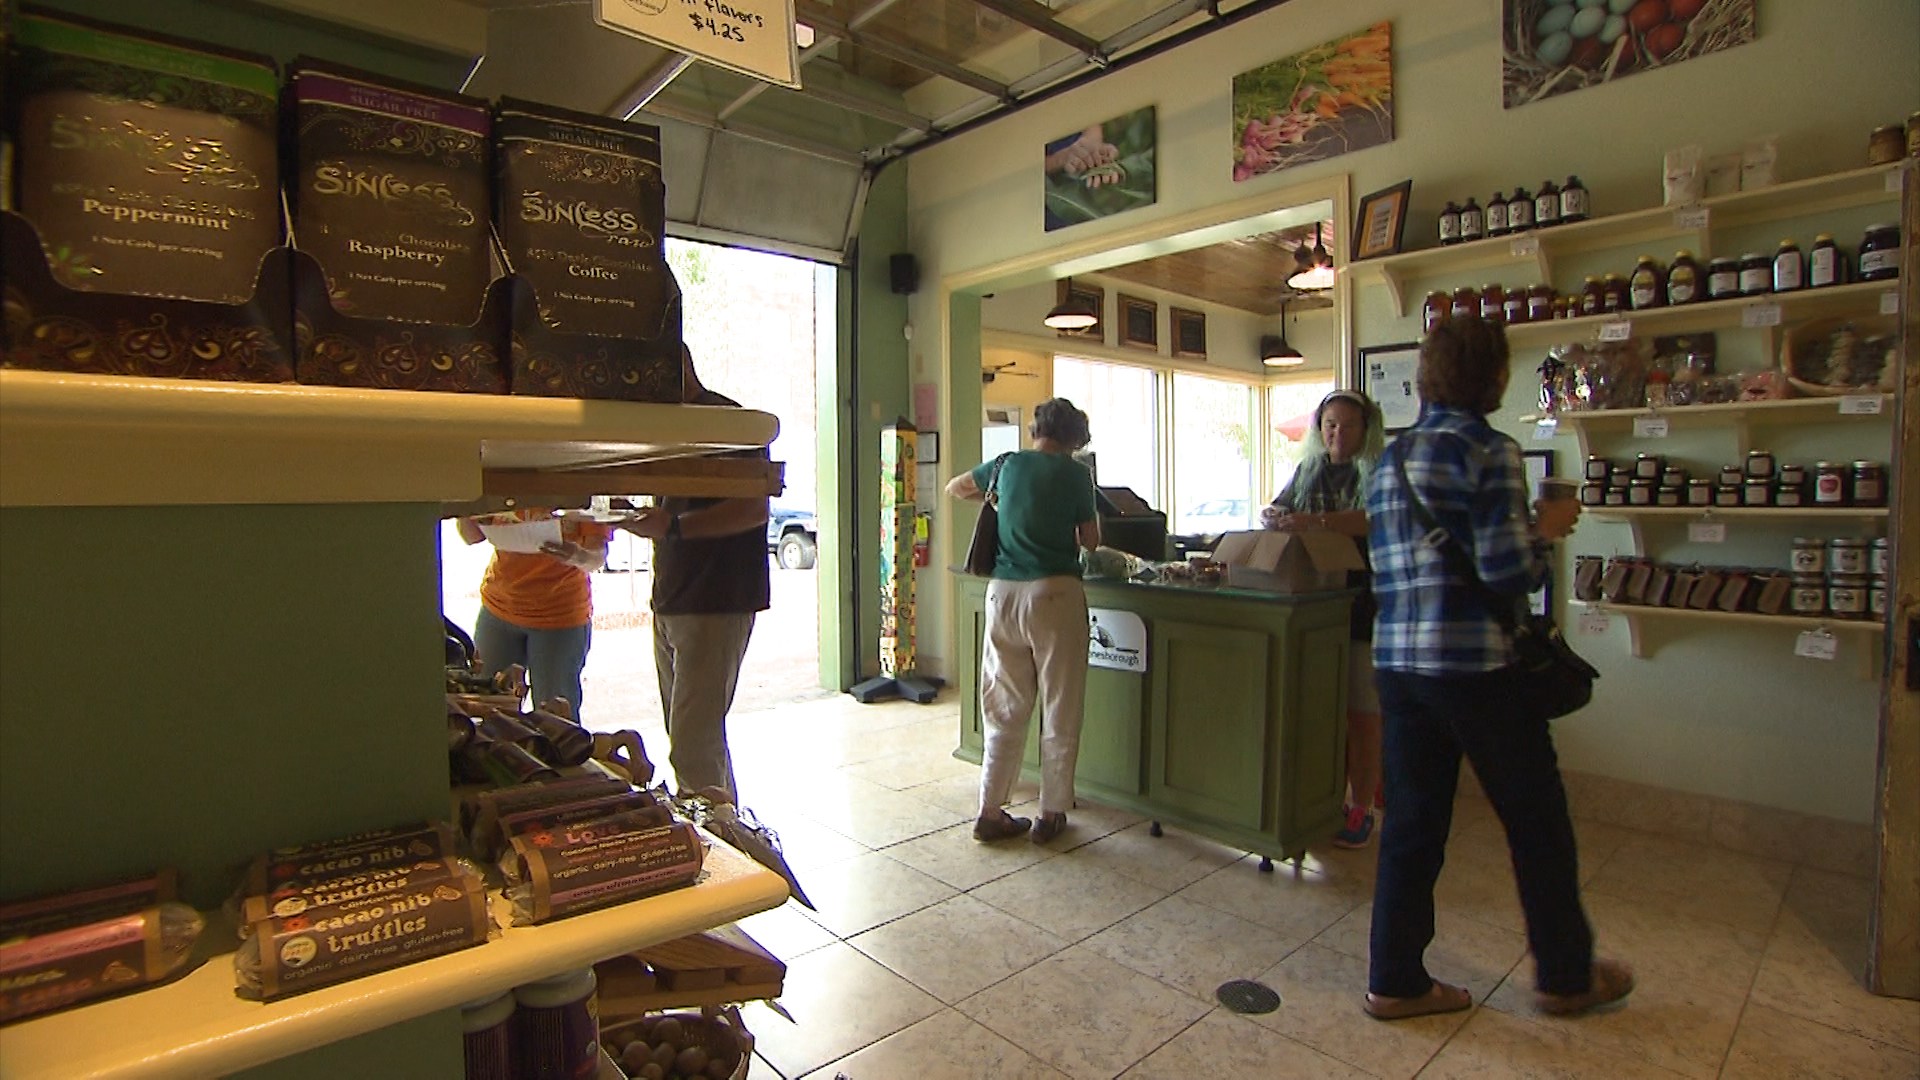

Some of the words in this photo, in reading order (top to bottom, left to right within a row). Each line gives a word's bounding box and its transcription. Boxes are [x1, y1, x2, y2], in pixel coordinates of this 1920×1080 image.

[688, 11, 746, 42] $4.25
[705, 0, 765, 28] flavors
[82, 198, 231, 231] Peppermint
[348, 239, 446, 268] Raspberry
[567, 263, 619, 281] Coffee
[300, 855, 363, 876] cacao
[369, 846, 406, 864] nib
[312, 878, 409, 907] truffles
[313, 906, 385, 933] cacao
[391, 893, 432, 915] nib
[326, 916, 427, 953] truffles
[283, 962, 333, 981] organic
[338, 944, 398, 966] dairy-free
[402, 926, 465, 951] gluten-free
